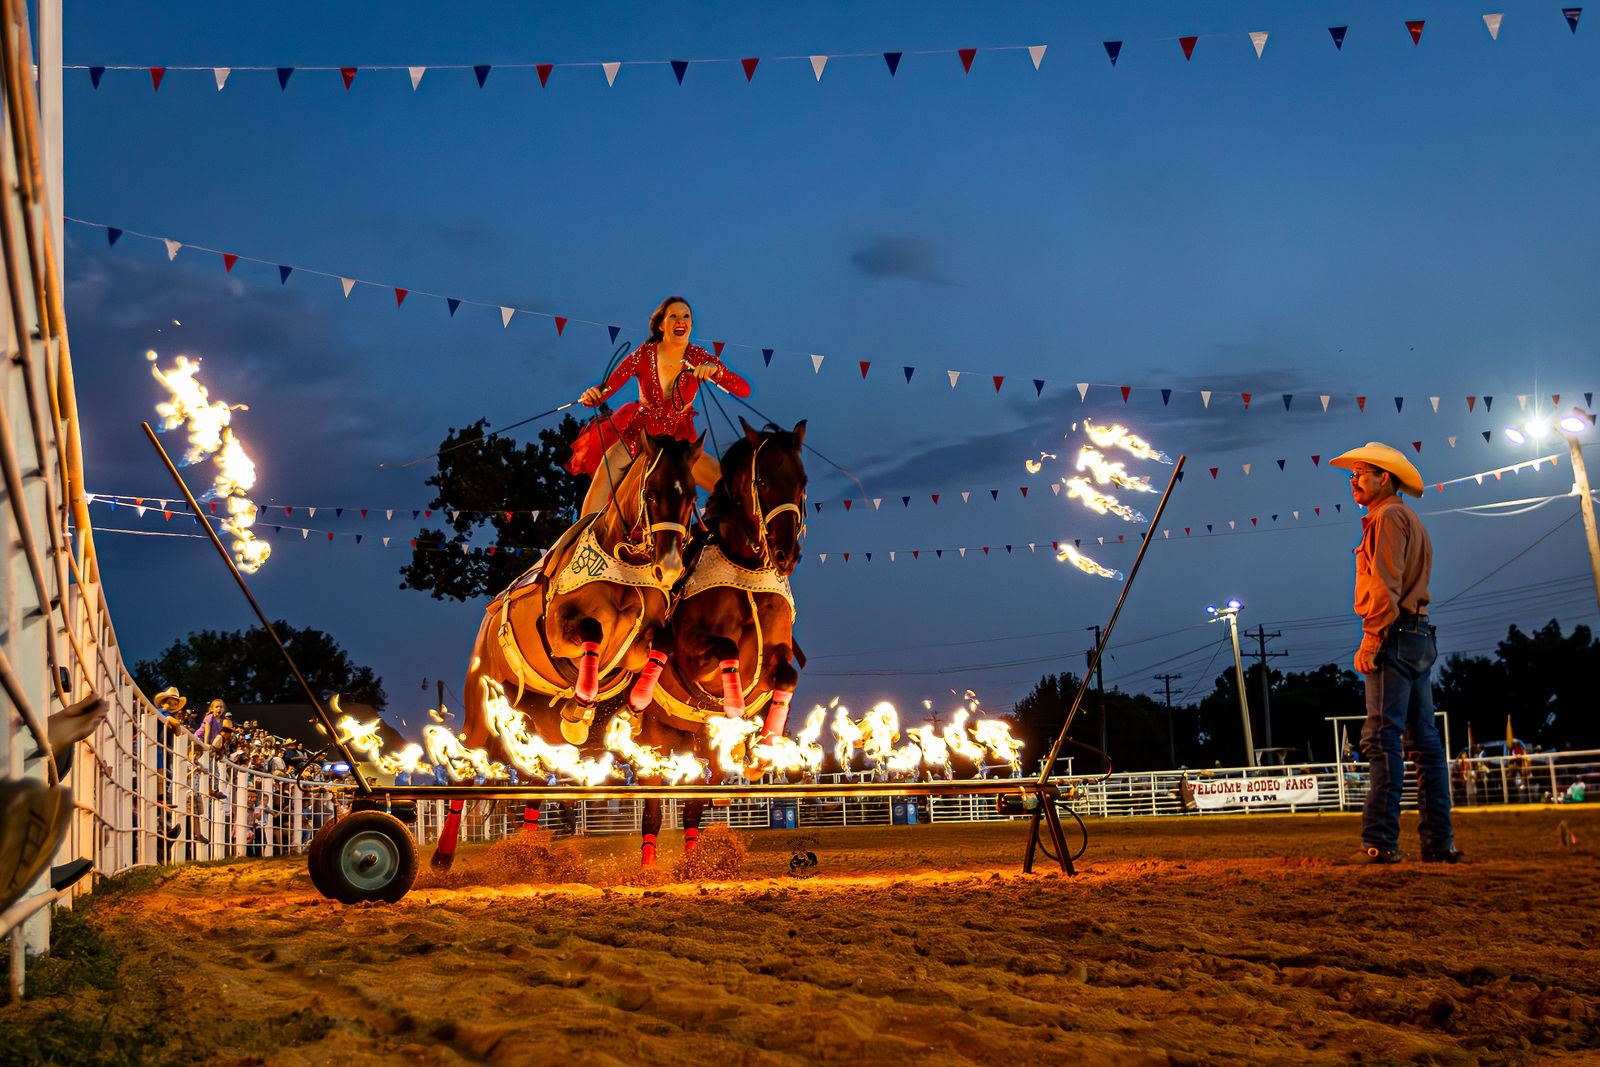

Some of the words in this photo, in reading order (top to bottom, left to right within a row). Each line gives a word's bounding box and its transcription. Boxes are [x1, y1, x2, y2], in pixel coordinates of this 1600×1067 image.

[1247, 780, 1280, 792] RODEO
[1285, 778, 1314, 790] FANS
[1239, 795, 1277, 803] RAM
